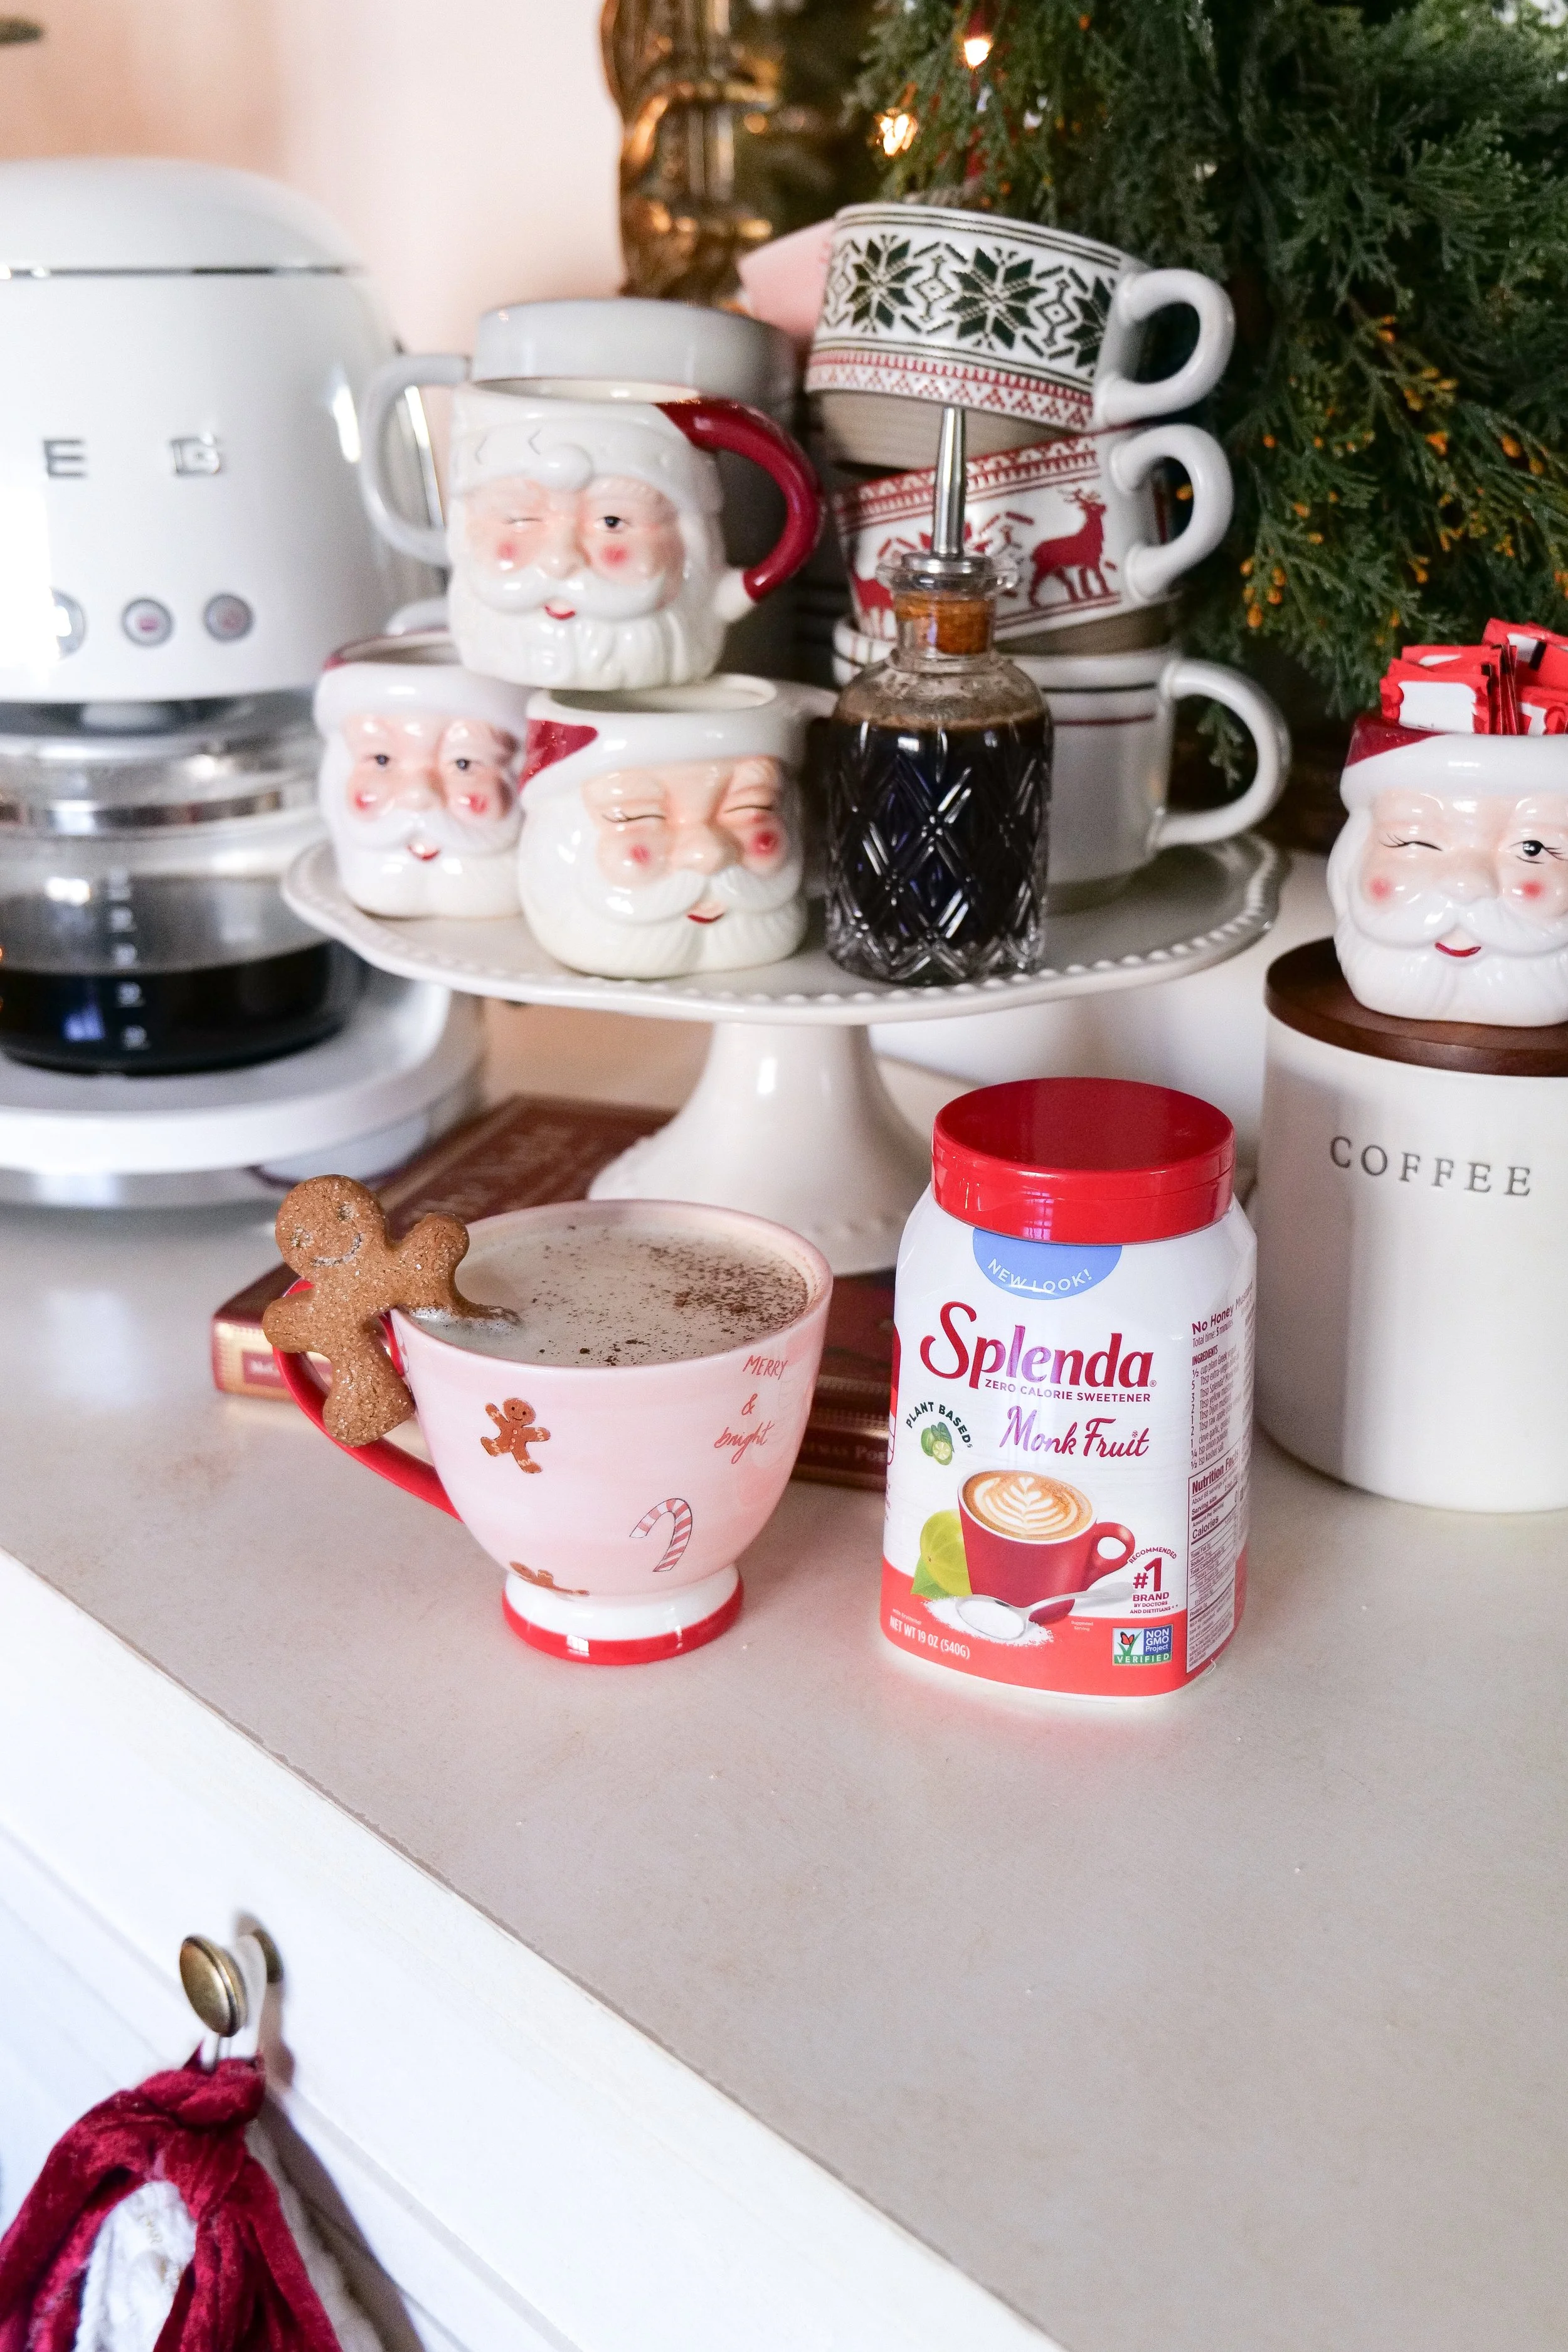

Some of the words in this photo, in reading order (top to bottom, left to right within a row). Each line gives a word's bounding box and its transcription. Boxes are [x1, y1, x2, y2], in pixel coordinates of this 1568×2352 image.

[1330, 1135, 1531, 1197] COFFEE
[987, 1258, 1028, 1289] NEW
[1192, 1321, 1207, 1335] No
[1210, 1304, 1234, 1327] Honey
[1192, 1335, 1204, 1347] Total
[1192, 1345, 1218, 1365] INGREDIENTS
[743, 1355, 788, 1380] MERRY
[985, 1379, 1016, 1393] ZERO
[1020, 1385, 1073, 1400] CALORIE
[1077, 1392, 1151, 1402] SWEETENER
[1191, 1380, 1195, 1389] 5
[741, 1392, 758, 1416] &
[1191, 1393, 1194, 1402] 3
[905, 1401, 934, 1429] PLANT
[1191, 1404, 1194, 1413] 2
[1191, 1416, 1193, 1424] 1
[999, 1405, 1078, 1455] Monk
[1083, 1417, 1150, 1458] Fruit
[1190, 1426, 1194, 1436] 2
[714, 1420, 775, 1465] bright
[1191, 1439, 1192, 1448] 1
[1192, 1465, 1224, 1494] Nutrition
[1193, 1516, 1219, 1539] Calories
[1129, 1547, 1177, 1564] RECOMMENDED
[1133, 1557, 1162, 1592] #1
[1133, 1592, 1170, 1602] BRAND
[890, 1615, 903, 1633] NET
[904, 1623, 916, 1639] WT
[918, 1629, 926, 1643] 19
[928, 1634, 938, 1648] OZ
[941, 1638, 970, 1660] (540G)
[1146, 1628, 1170, 1638] NON
[1146, 1636, 1169, 1646] GMO
[1116, 1653, 1170, 1663] VERIFIED
[1145, 1644, 1168, 1653] Project
